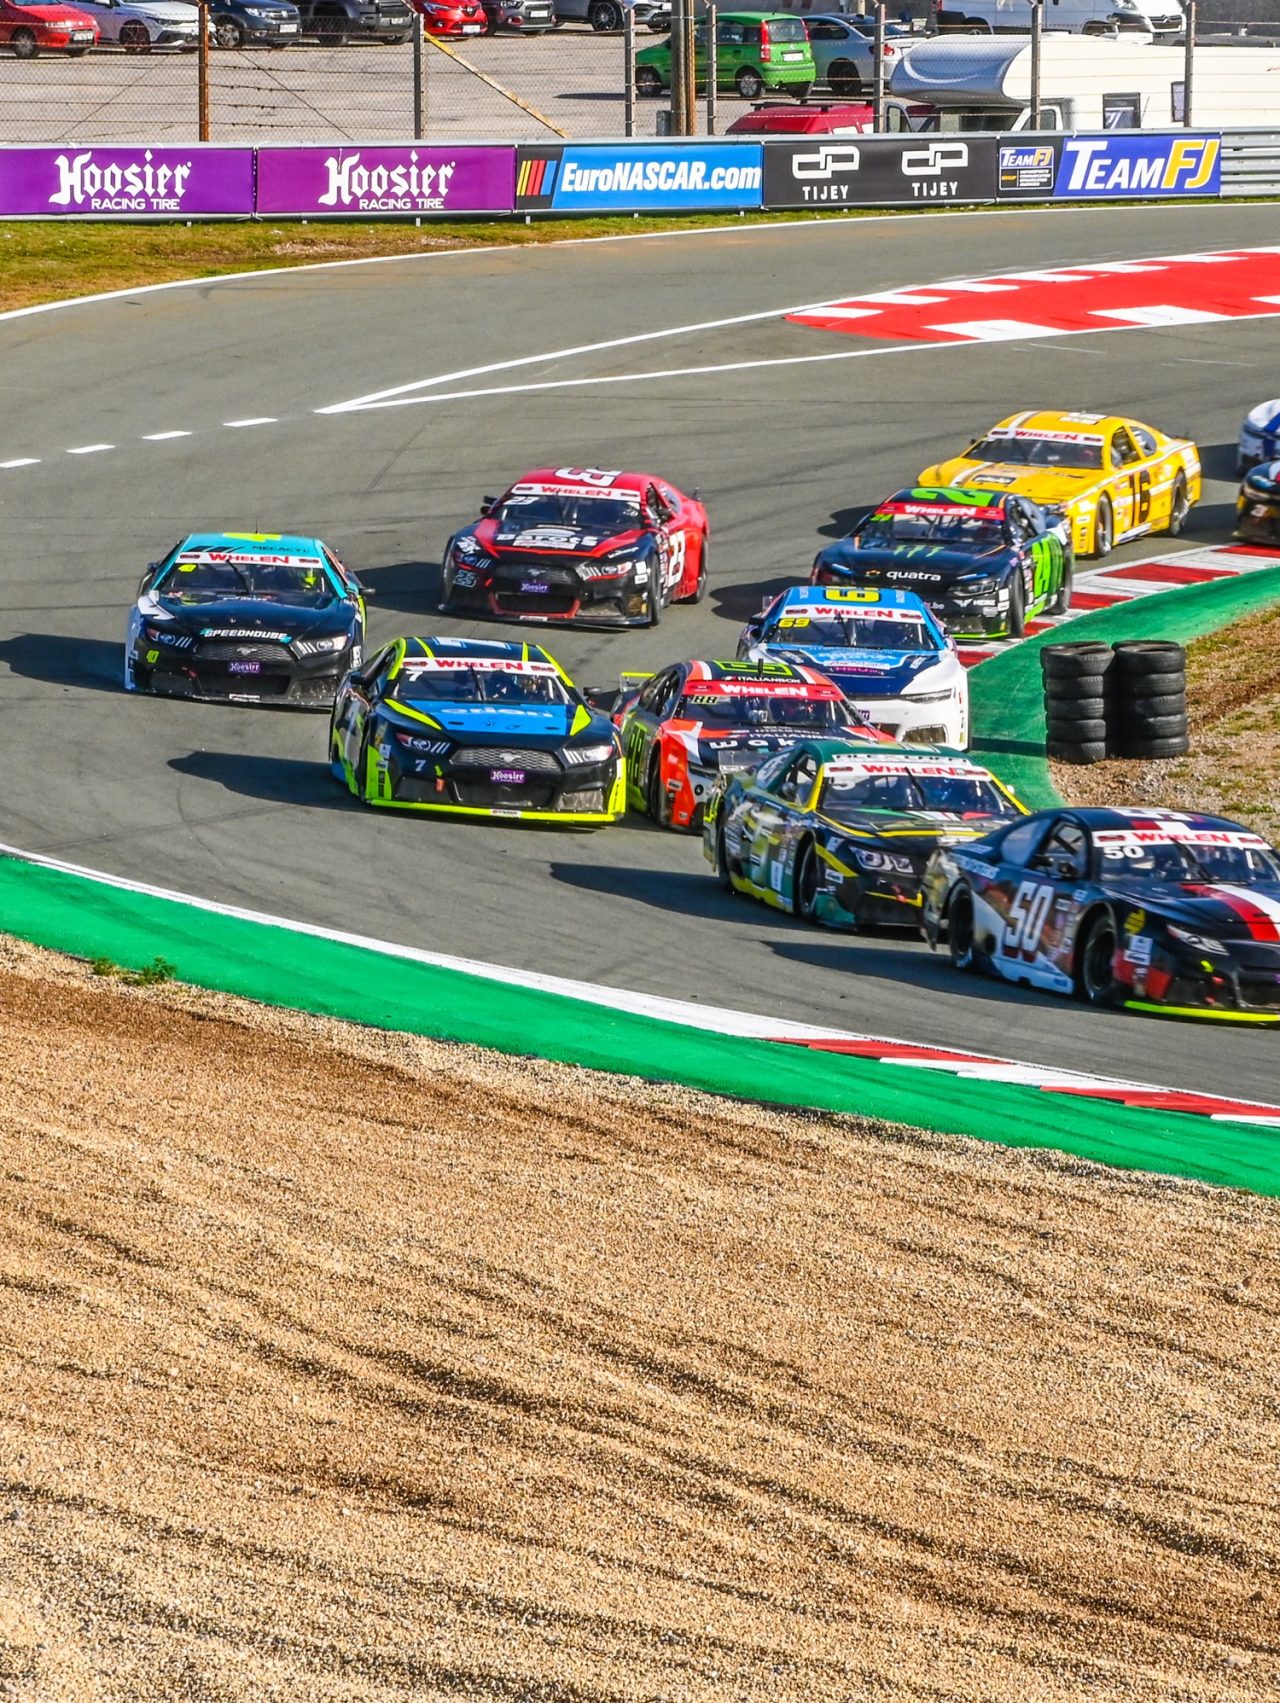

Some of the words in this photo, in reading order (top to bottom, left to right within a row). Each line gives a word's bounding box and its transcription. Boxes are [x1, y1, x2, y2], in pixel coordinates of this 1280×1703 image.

[48, 150, 192, 205] Hoosier
[318, 151, 456, 206] Hoosier
[561, 160, 762, 192] EuroNASCAR.com
[802, 184, 849, 201] TIJEY
[912, 181, 959, 197] TIJEY
[91, 198, 146, 211] RACING
[150, 198, 180, 211] TIRE
[359, 198, 414, 211] RACING
[417, 197, 445, 210] TIRE
[540, 485, 612, 497] WHELEN
[904, 504, 977, 516] WHELEN
[208, 552, 290, 564] WHELEN
[886, 569, 942, 582] quatra
[815, 607, 894, 619] WHELEN
[778, 617, 811, 628] 69
[434, 659, 524, 671] WHELEN
[405, 670, 424, 682] 7
[719, 683, 809, 697] WHELEN
[415, 759, 427, 772] 7
[861, 764, 957, 777] WHELEN
[1131, 831, 1233, 844] WHELEN
[1103, 845, 1146, 860] 50
[1003, 880, 1055, 953] 50
